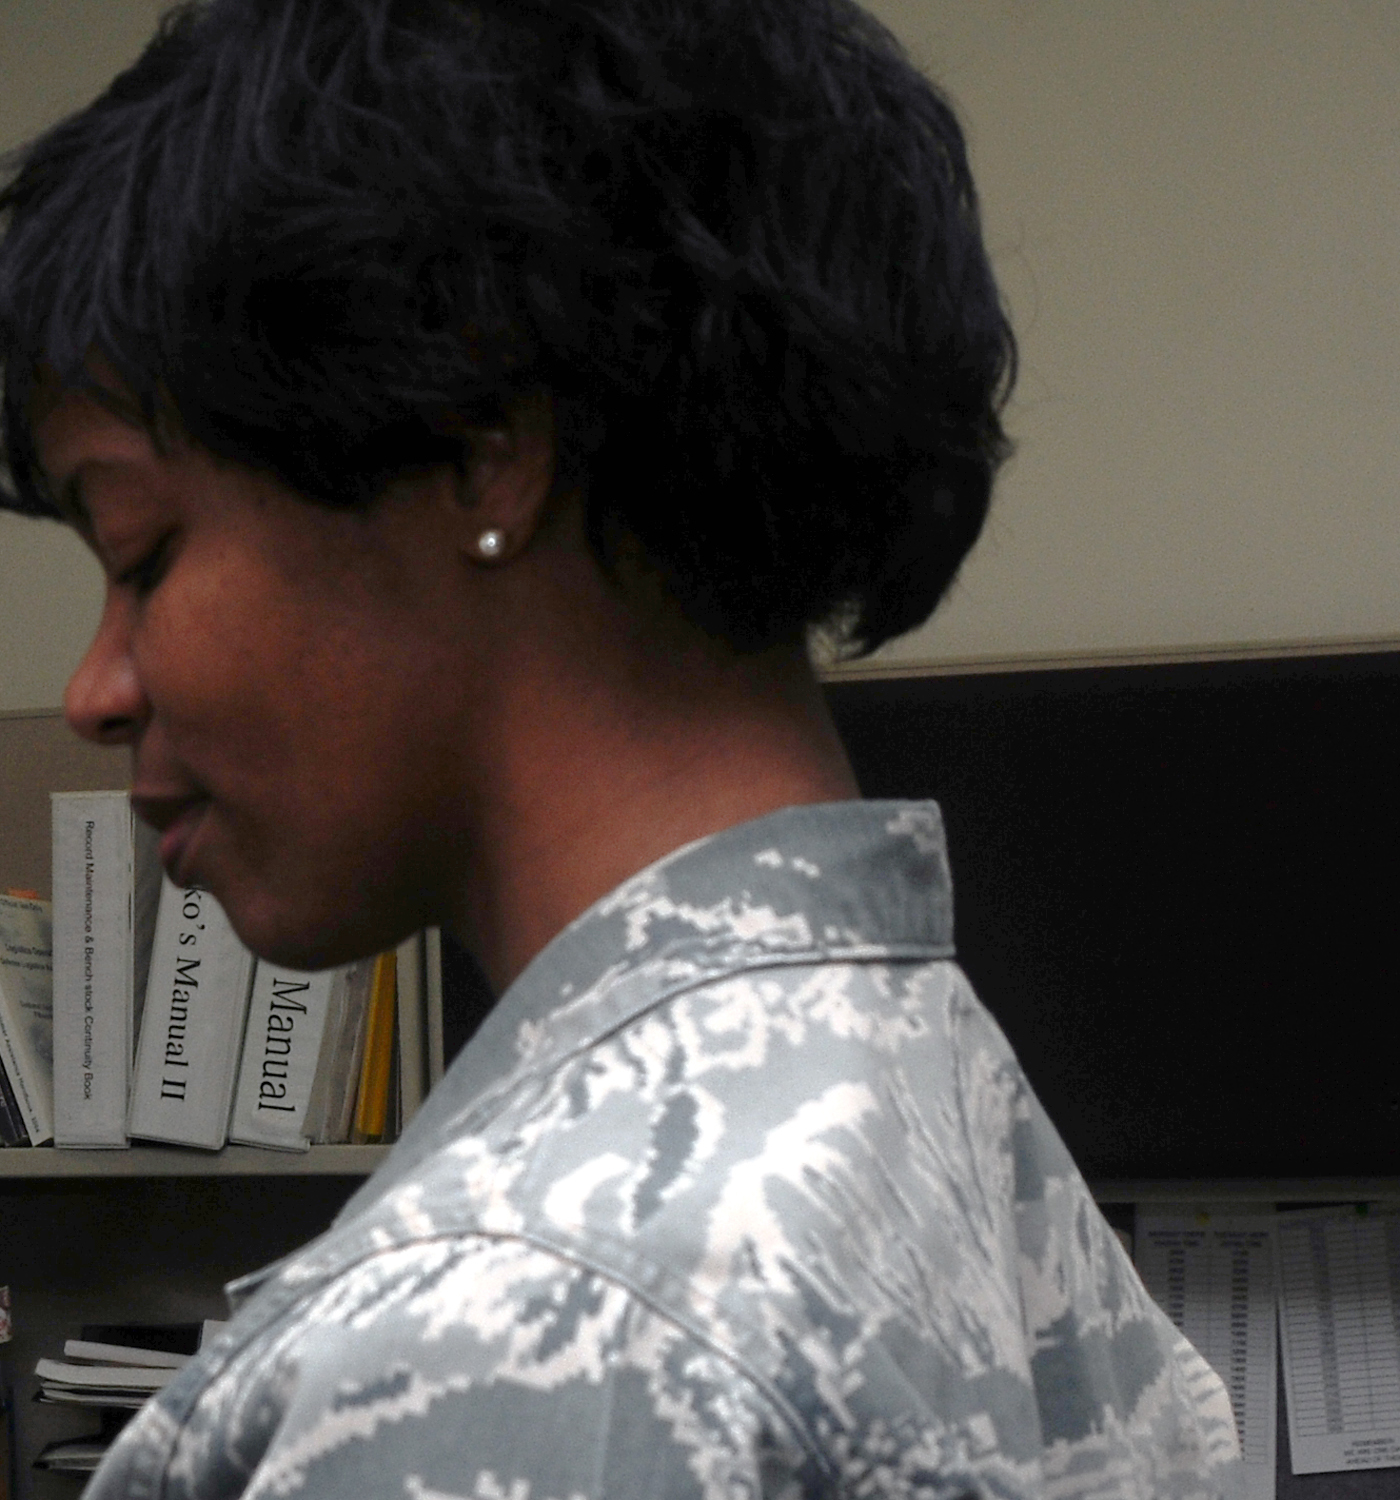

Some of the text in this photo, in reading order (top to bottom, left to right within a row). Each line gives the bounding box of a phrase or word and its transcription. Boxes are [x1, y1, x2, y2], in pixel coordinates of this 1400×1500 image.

[85, 821, 95, 860] Record
[84, 863, 94, 933] Maintenance
[84, 935, 94, 944] &
[84, 947, 94, 982] Bench
[165, 957, 202, 1067] Manual
[82, 1015, 94, 1070] Continuity
[258, 977, 311, 1112] Manual
[83, 1072, 94, 1100] Book
[160, 1076, 187, 1101] II
